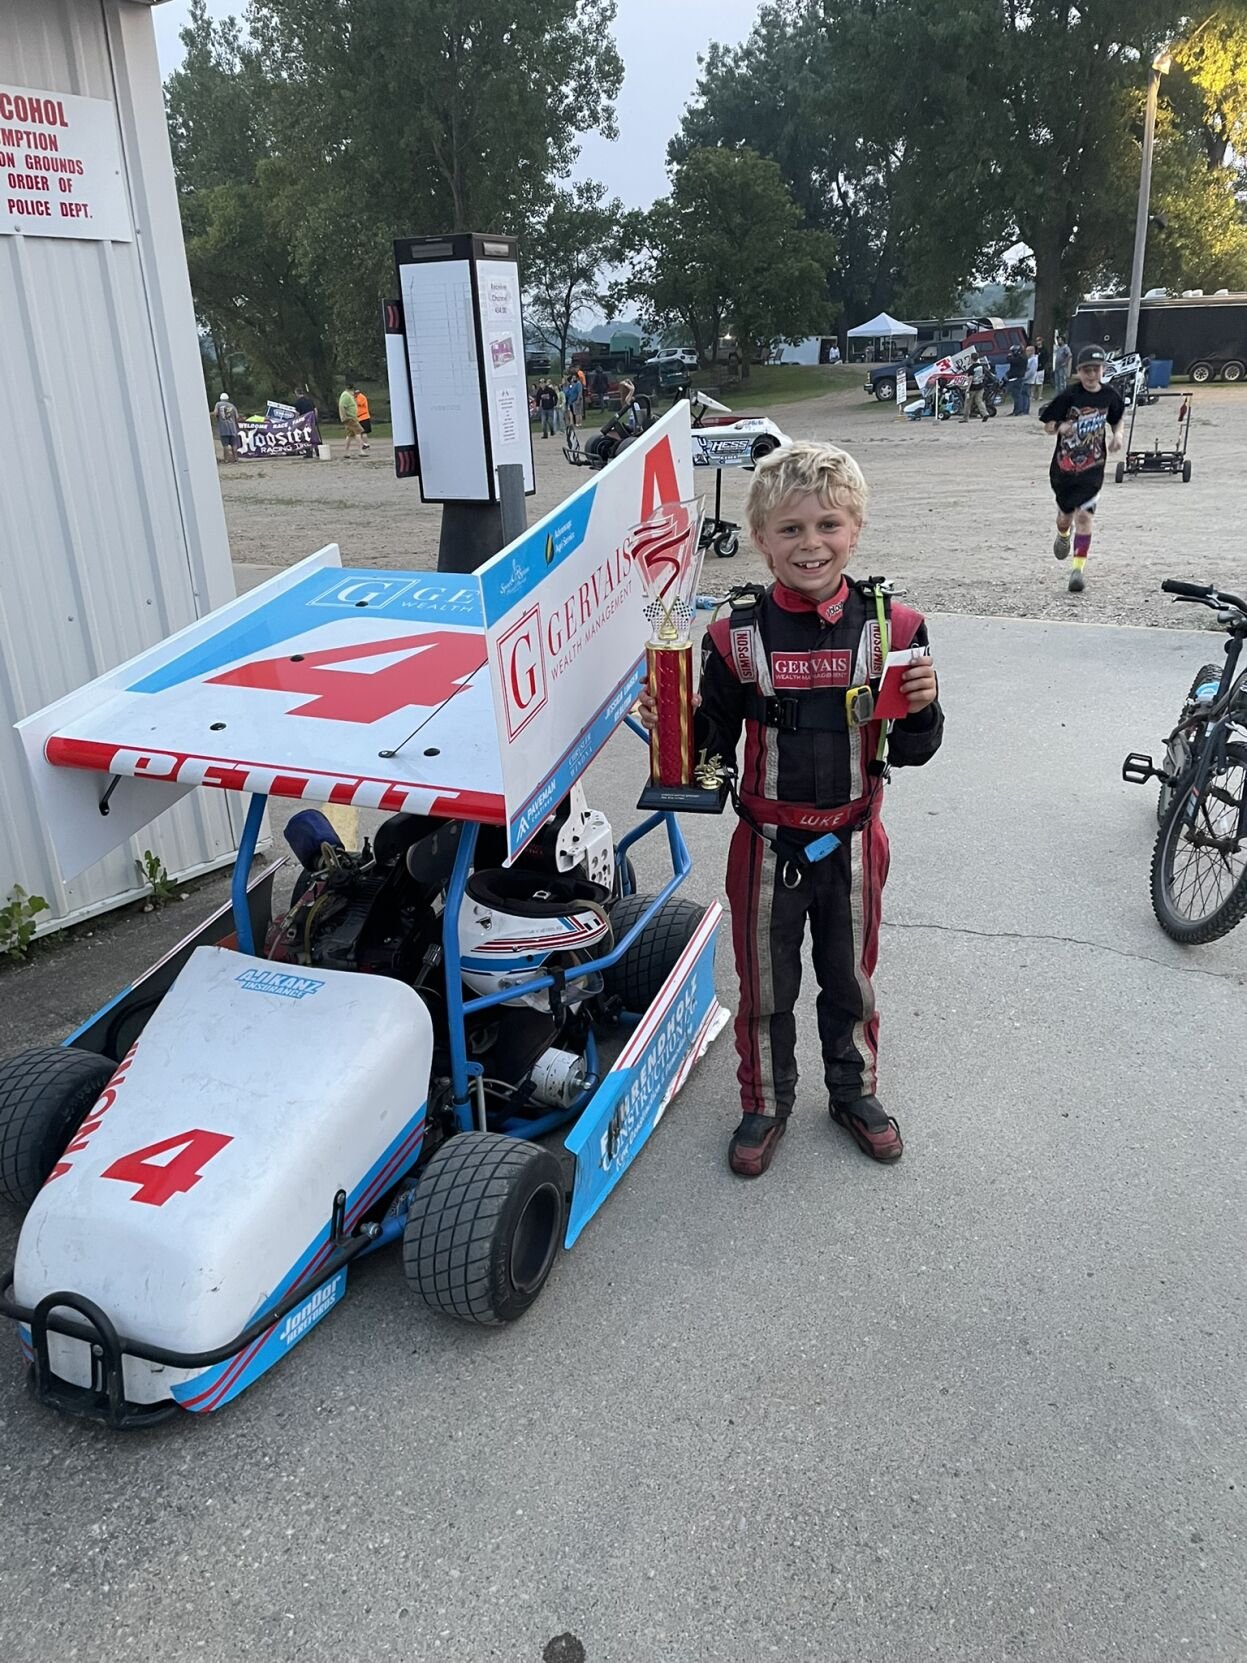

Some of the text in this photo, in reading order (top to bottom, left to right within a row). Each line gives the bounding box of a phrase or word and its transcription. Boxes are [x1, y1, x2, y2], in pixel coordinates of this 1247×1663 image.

[0, 92, 69, 128] COHOL
[0, 127, 59, 152] MPTION
[0, 151, 84, 175] ON GROUNDS
[7, 172, 73, 193] ORDER OF
[7, 198, 93, 219] POLICE DEPT.
[237, 422, 269, 430] WELCOME
[272, 421, 289, 430] RACE
[237, 424, 312, 455] Hoosier
[260, 444, 293, 454] RACING
[711, 440, 749, 452] HESS
[336, 580, 394, 603] G
[547, 536, 634, 657] GERVAIS
[401, 600, 475, 613] WEALTH
[550, 579, 633, 681] WEALTH MANAGEMENT
[736, 632, 753, 678] SIMPSON
[774, 657, 848, 674] GERVAIS
[201, 630, 488, 725] 4
[510, 631, 537, 710] G
[526, 777, 557, 820] PAVEMAN
[799, 812, 845, 827] LUKE
[241, 980, 306, 999] INSURANCE
[265, 973, 326, 994] KANZ
[600, 972, 698, 1156] FHRENDHOLZ
[99, 1127, 235, 1207] 4
